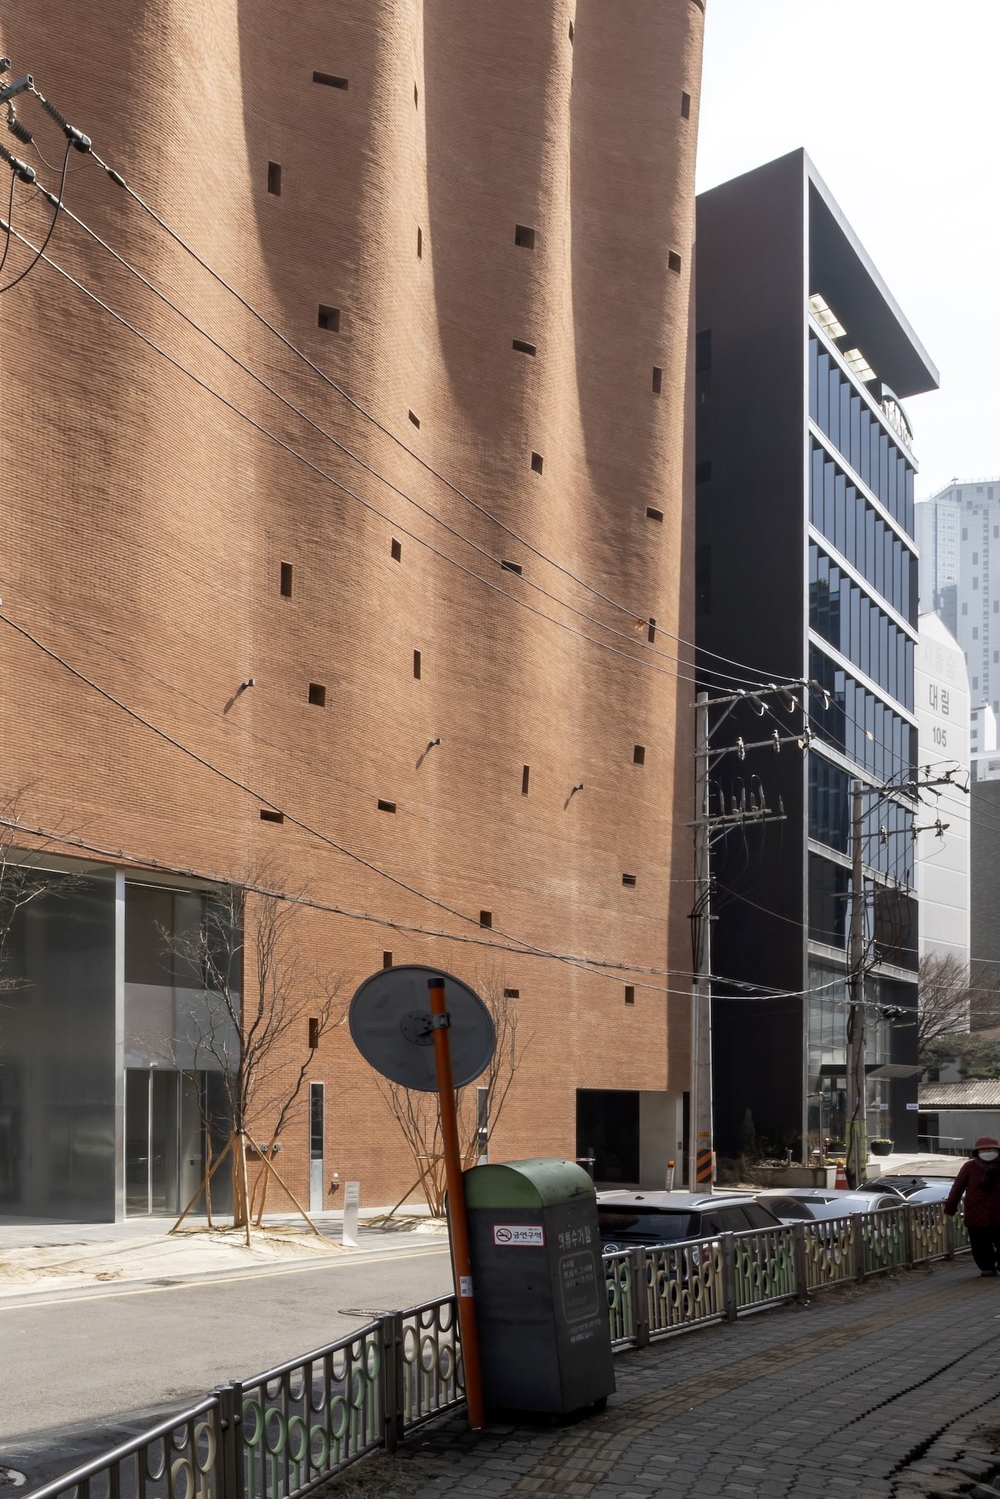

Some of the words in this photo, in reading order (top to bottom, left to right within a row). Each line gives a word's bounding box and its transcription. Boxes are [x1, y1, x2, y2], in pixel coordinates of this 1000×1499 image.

[929, 683, 949, 716] 대림
[933, 726, 947, 747] 105
[512, 1231, 542, 1240] 금연구역
